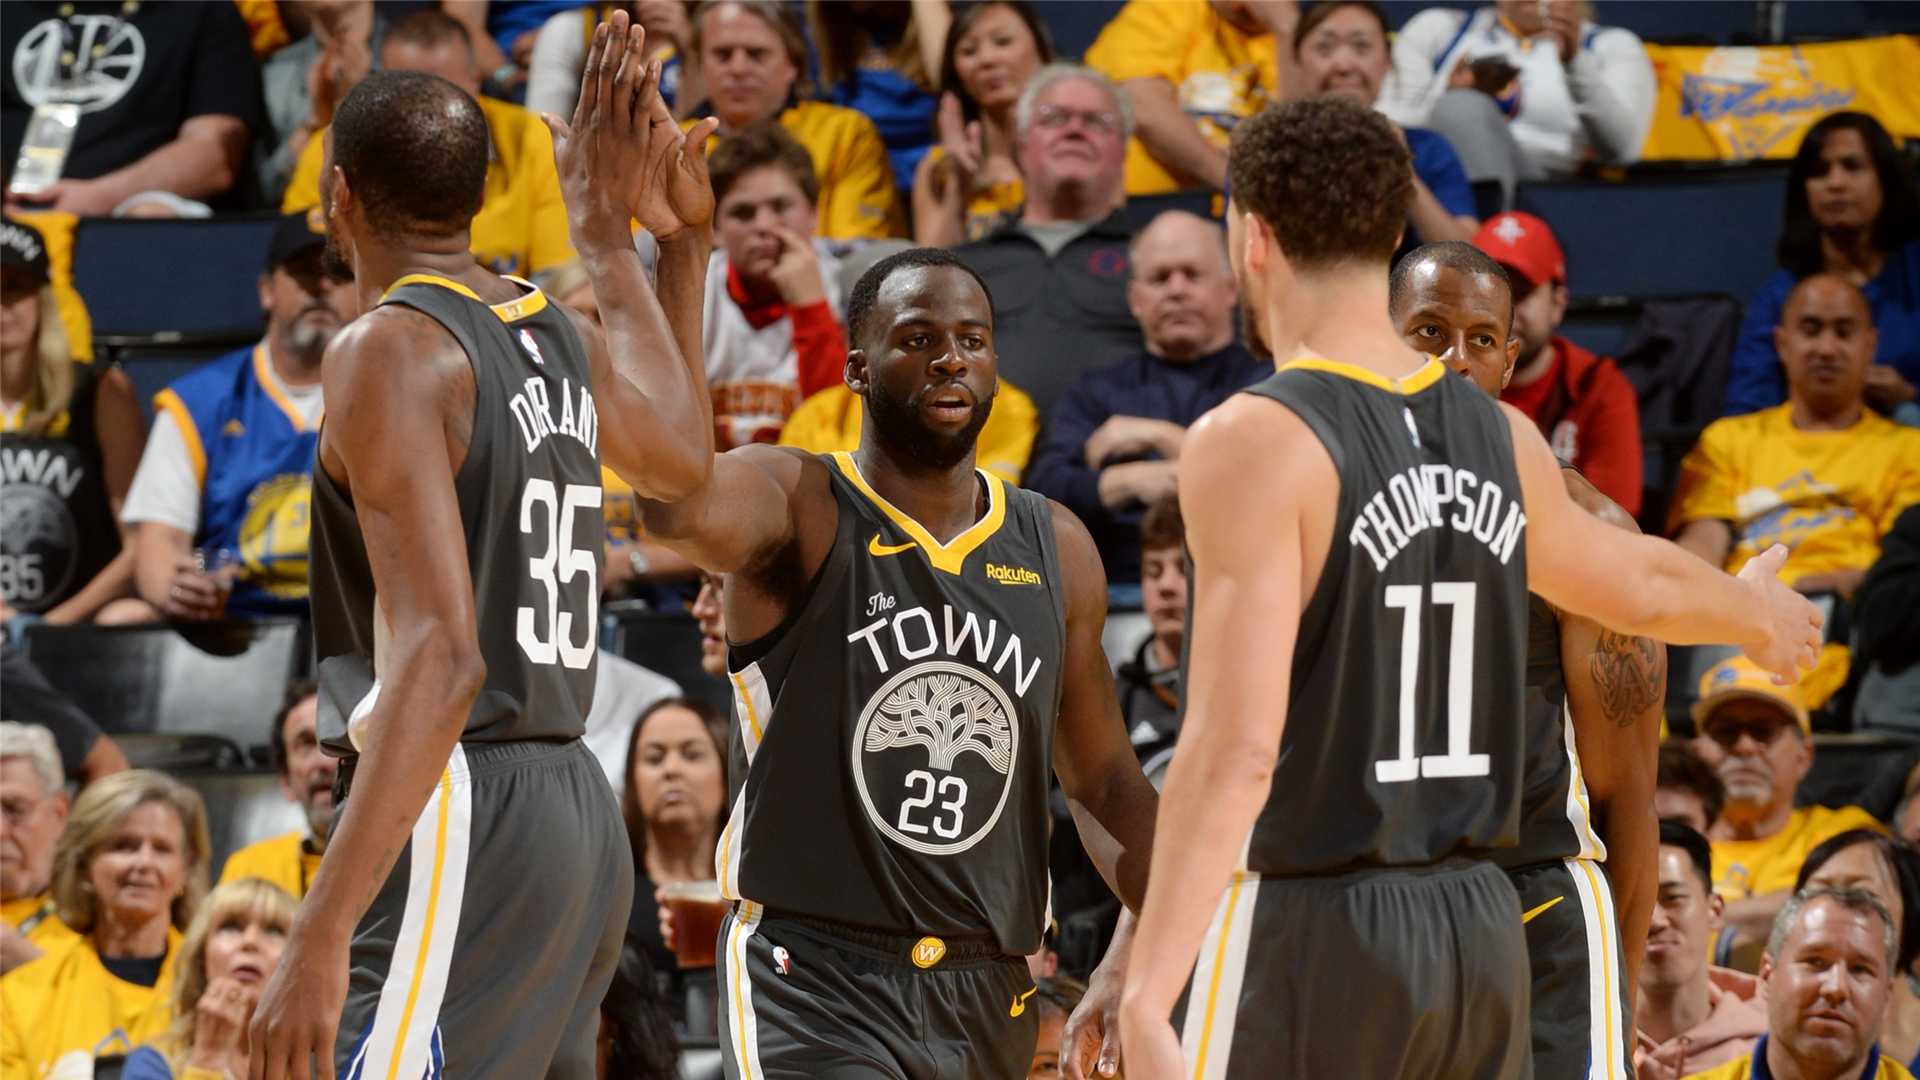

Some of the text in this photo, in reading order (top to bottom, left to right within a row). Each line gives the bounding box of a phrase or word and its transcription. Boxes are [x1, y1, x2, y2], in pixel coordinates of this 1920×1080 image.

[1350, 464, 1527, 573] THOMPSON
[516, 477, 602, 670] 35
[866, 591, 896, 617] The
[986, 563, 1041, 585] Rakuten
[847, 604, 1042, 699] TOWN
[1375, 581, 1490, 783] 11
[898, 769, 968, 839] 23
[919, 944, 944, 962] W
